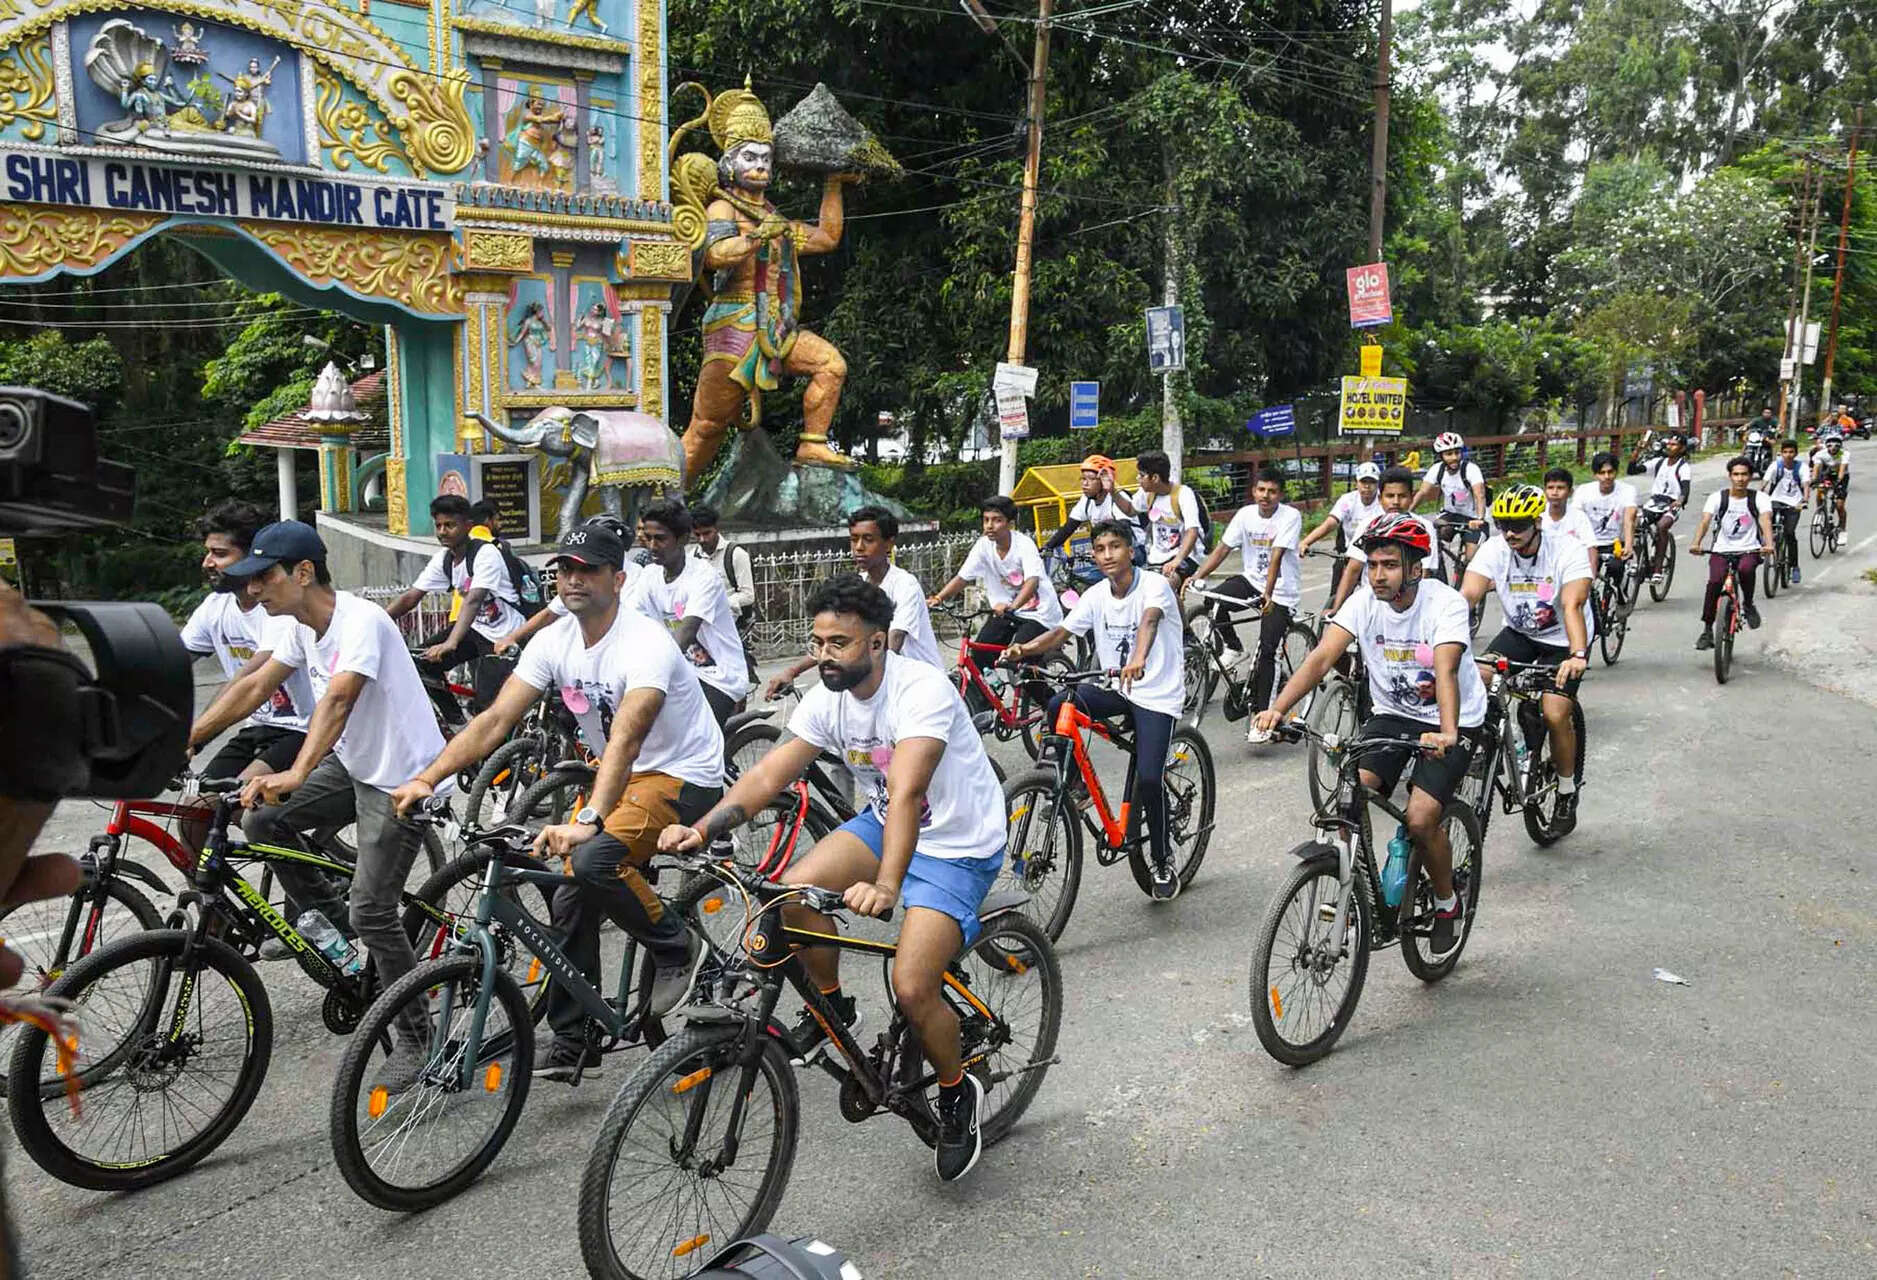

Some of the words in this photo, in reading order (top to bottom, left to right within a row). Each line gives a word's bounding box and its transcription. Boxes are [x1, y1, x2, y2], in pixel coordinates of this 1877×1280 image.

[5, 153, 91, 206] SHRI
[105, 162, 239, 216] GANESH
[249, 174, 364, 226] MANDIR
[374, 186, 446, 229] GATE
[1355, 270, 1380, 292] glo
[1374, 393, 1403, 405] UNITED
[232, 877, 305, 953] HERCULES
[516, 918, 574, 979] ROCKRIDER
